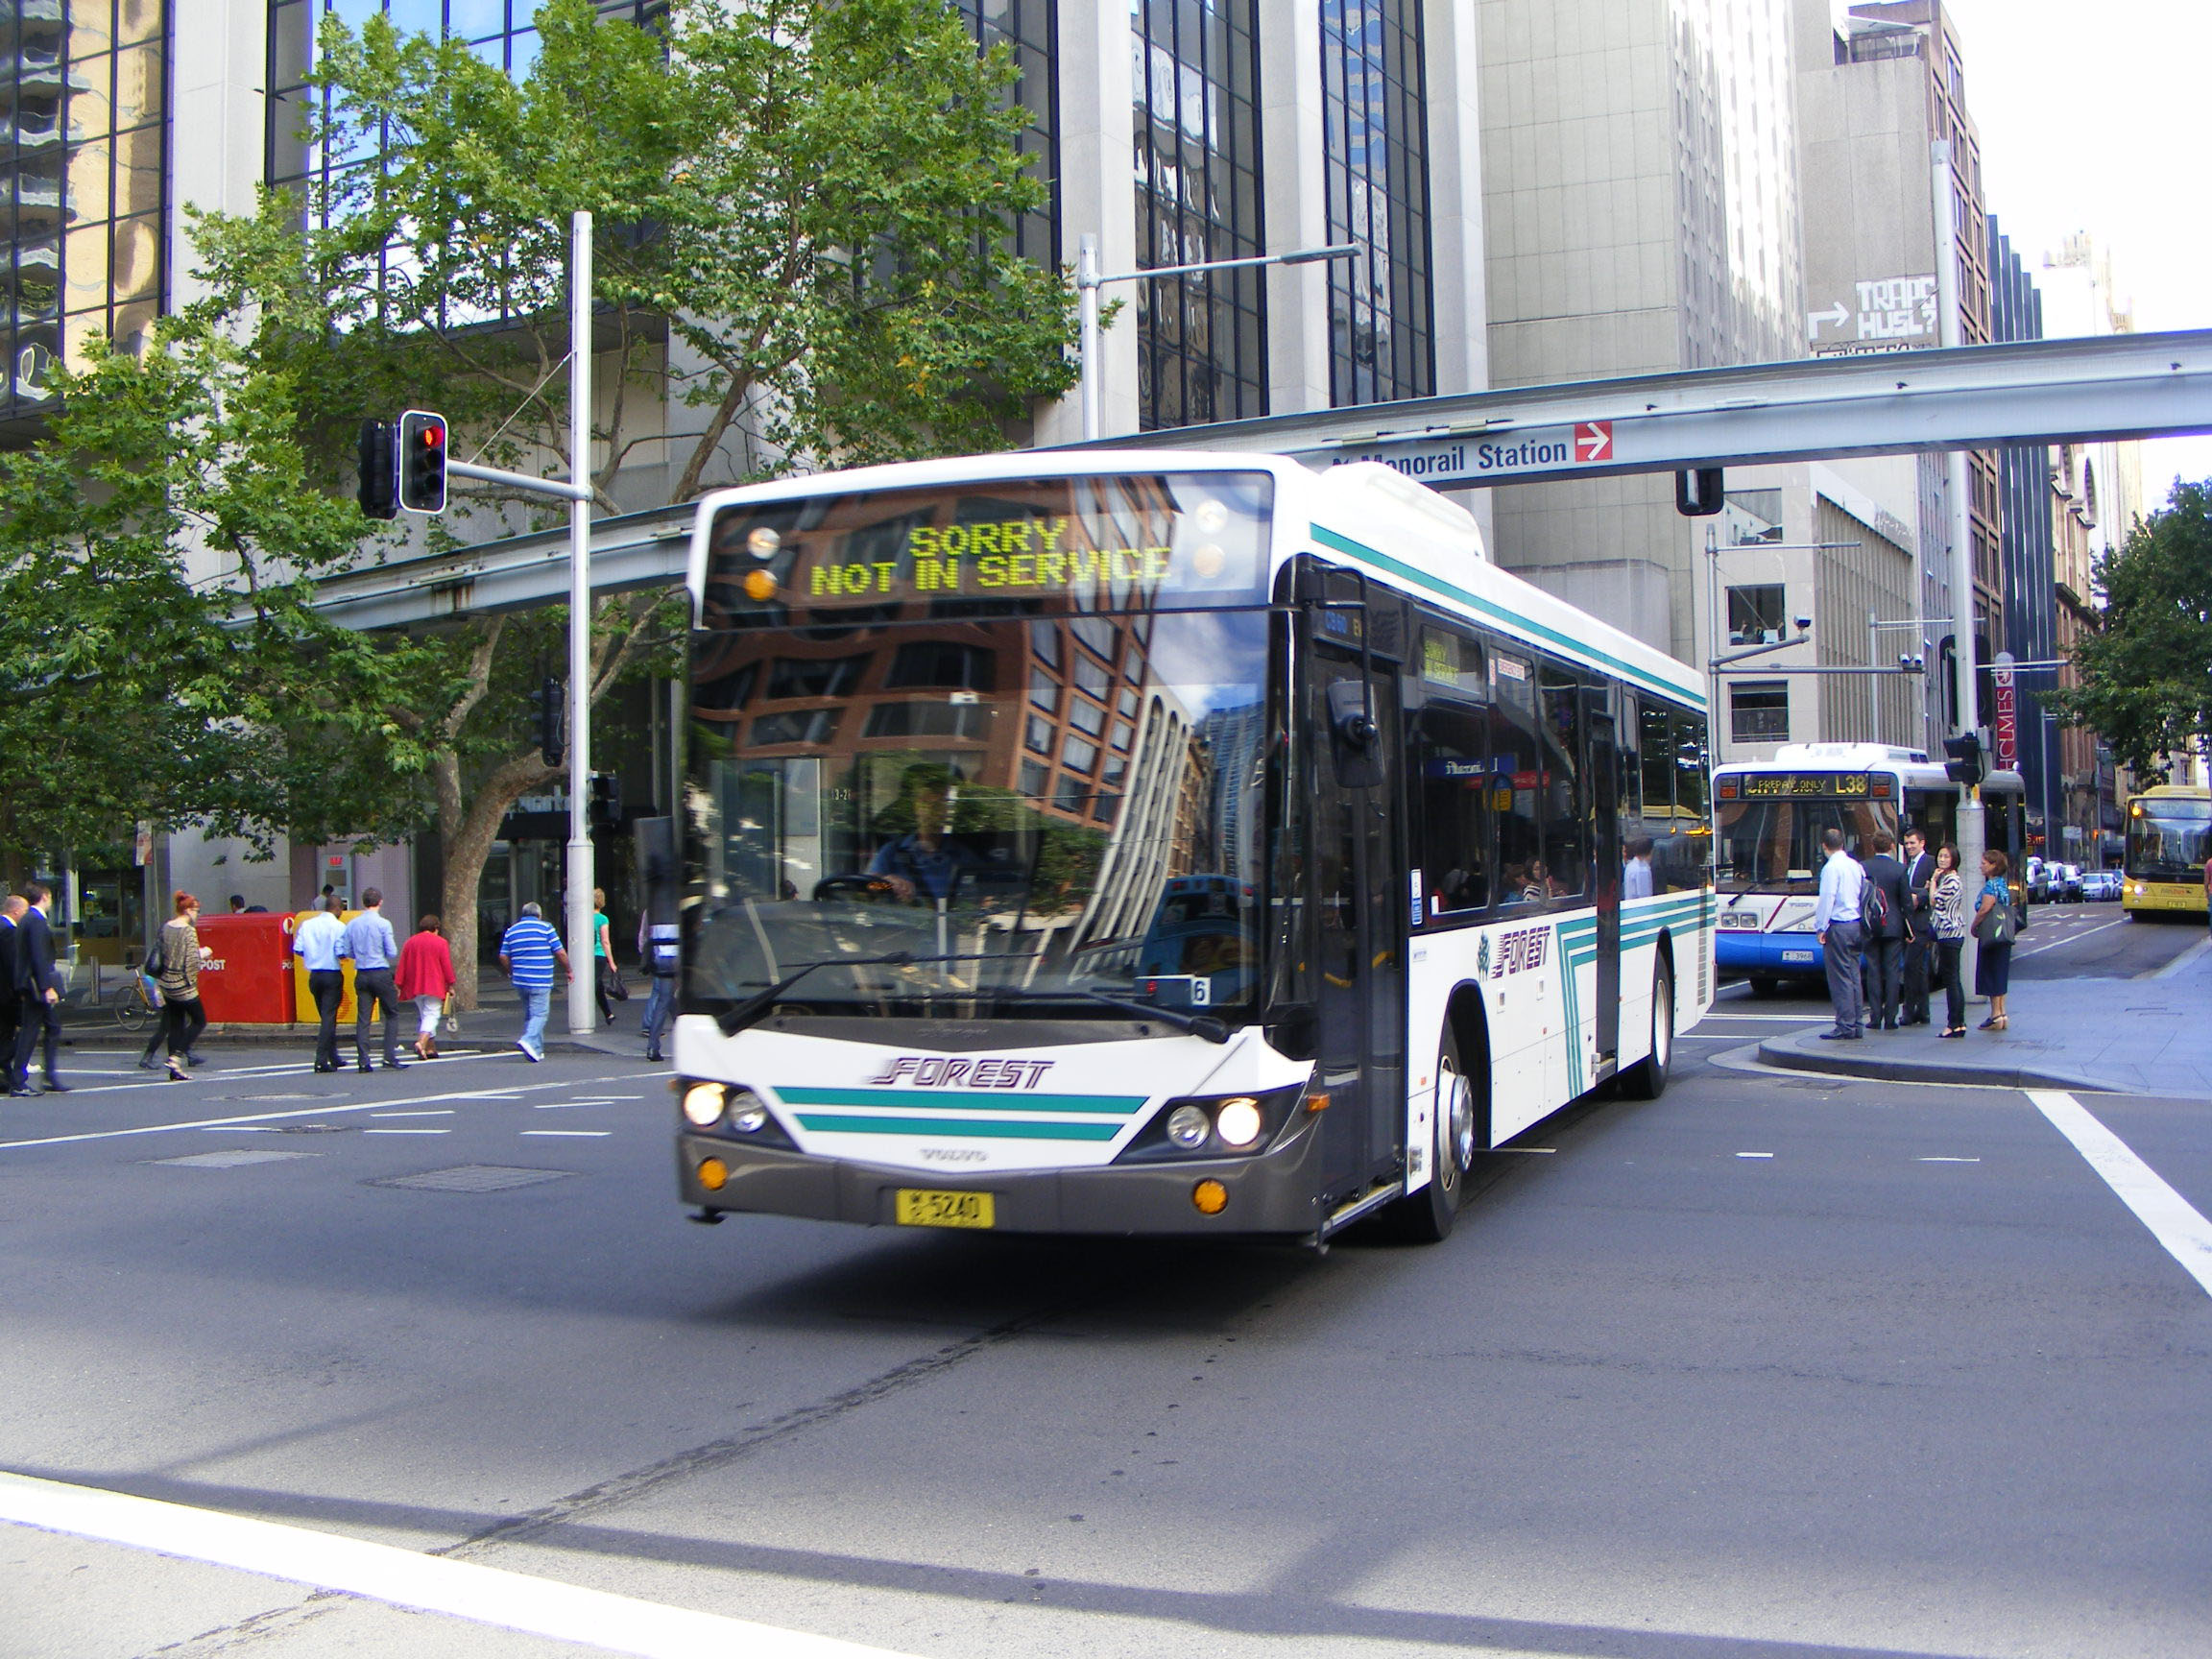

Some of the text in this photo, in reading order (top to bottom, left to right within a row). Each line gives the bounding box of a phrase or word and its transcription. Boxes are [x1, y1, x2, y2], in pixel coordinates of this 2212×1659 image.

[1479, 439, 1567, 469] Station
[908, 518, 1068, 559] SORRY
[811, 546, 1172, 596] NOT IN SERVICE
[1835, 774, 1866, 795] L38
[200, 959, 226, 972] POST
[1491, 926, 1551, 979] FOREST
[1194, 980, 1206, 1001] 6
[870, 1057, 1055, 1090] FOREST
